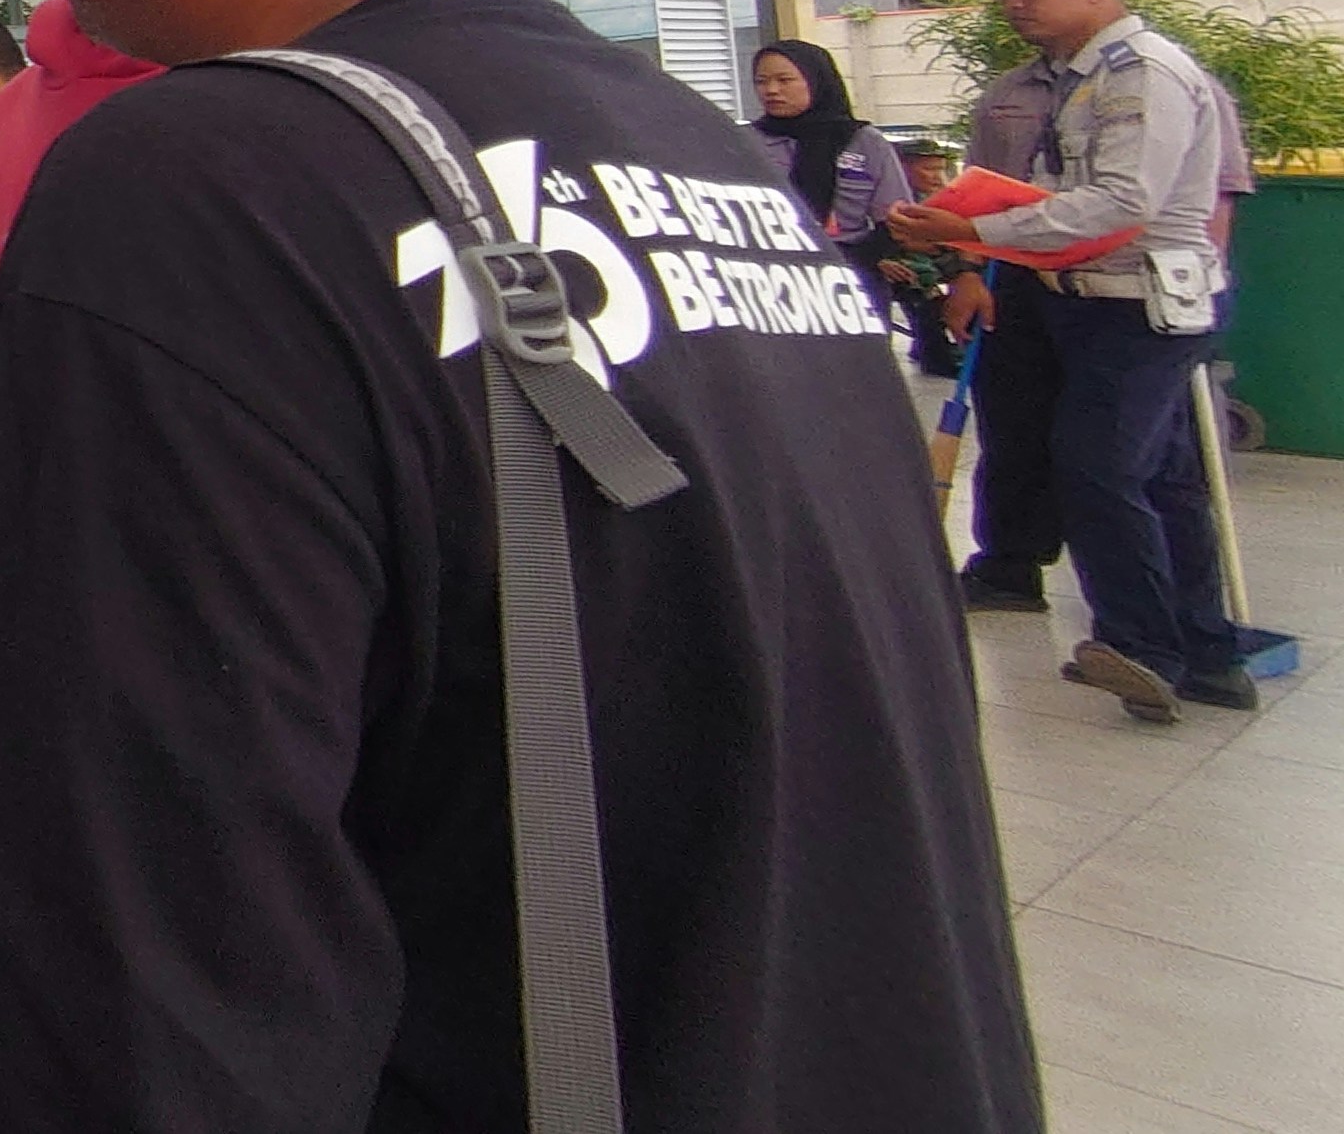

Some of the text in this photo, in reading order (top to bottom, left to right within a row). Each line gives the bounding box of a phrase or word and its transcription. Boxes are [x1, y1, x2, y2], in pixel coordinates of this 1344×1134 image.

[592, 164, 818, 252] BE BETTER
[649, 251, 739, 333] BE
